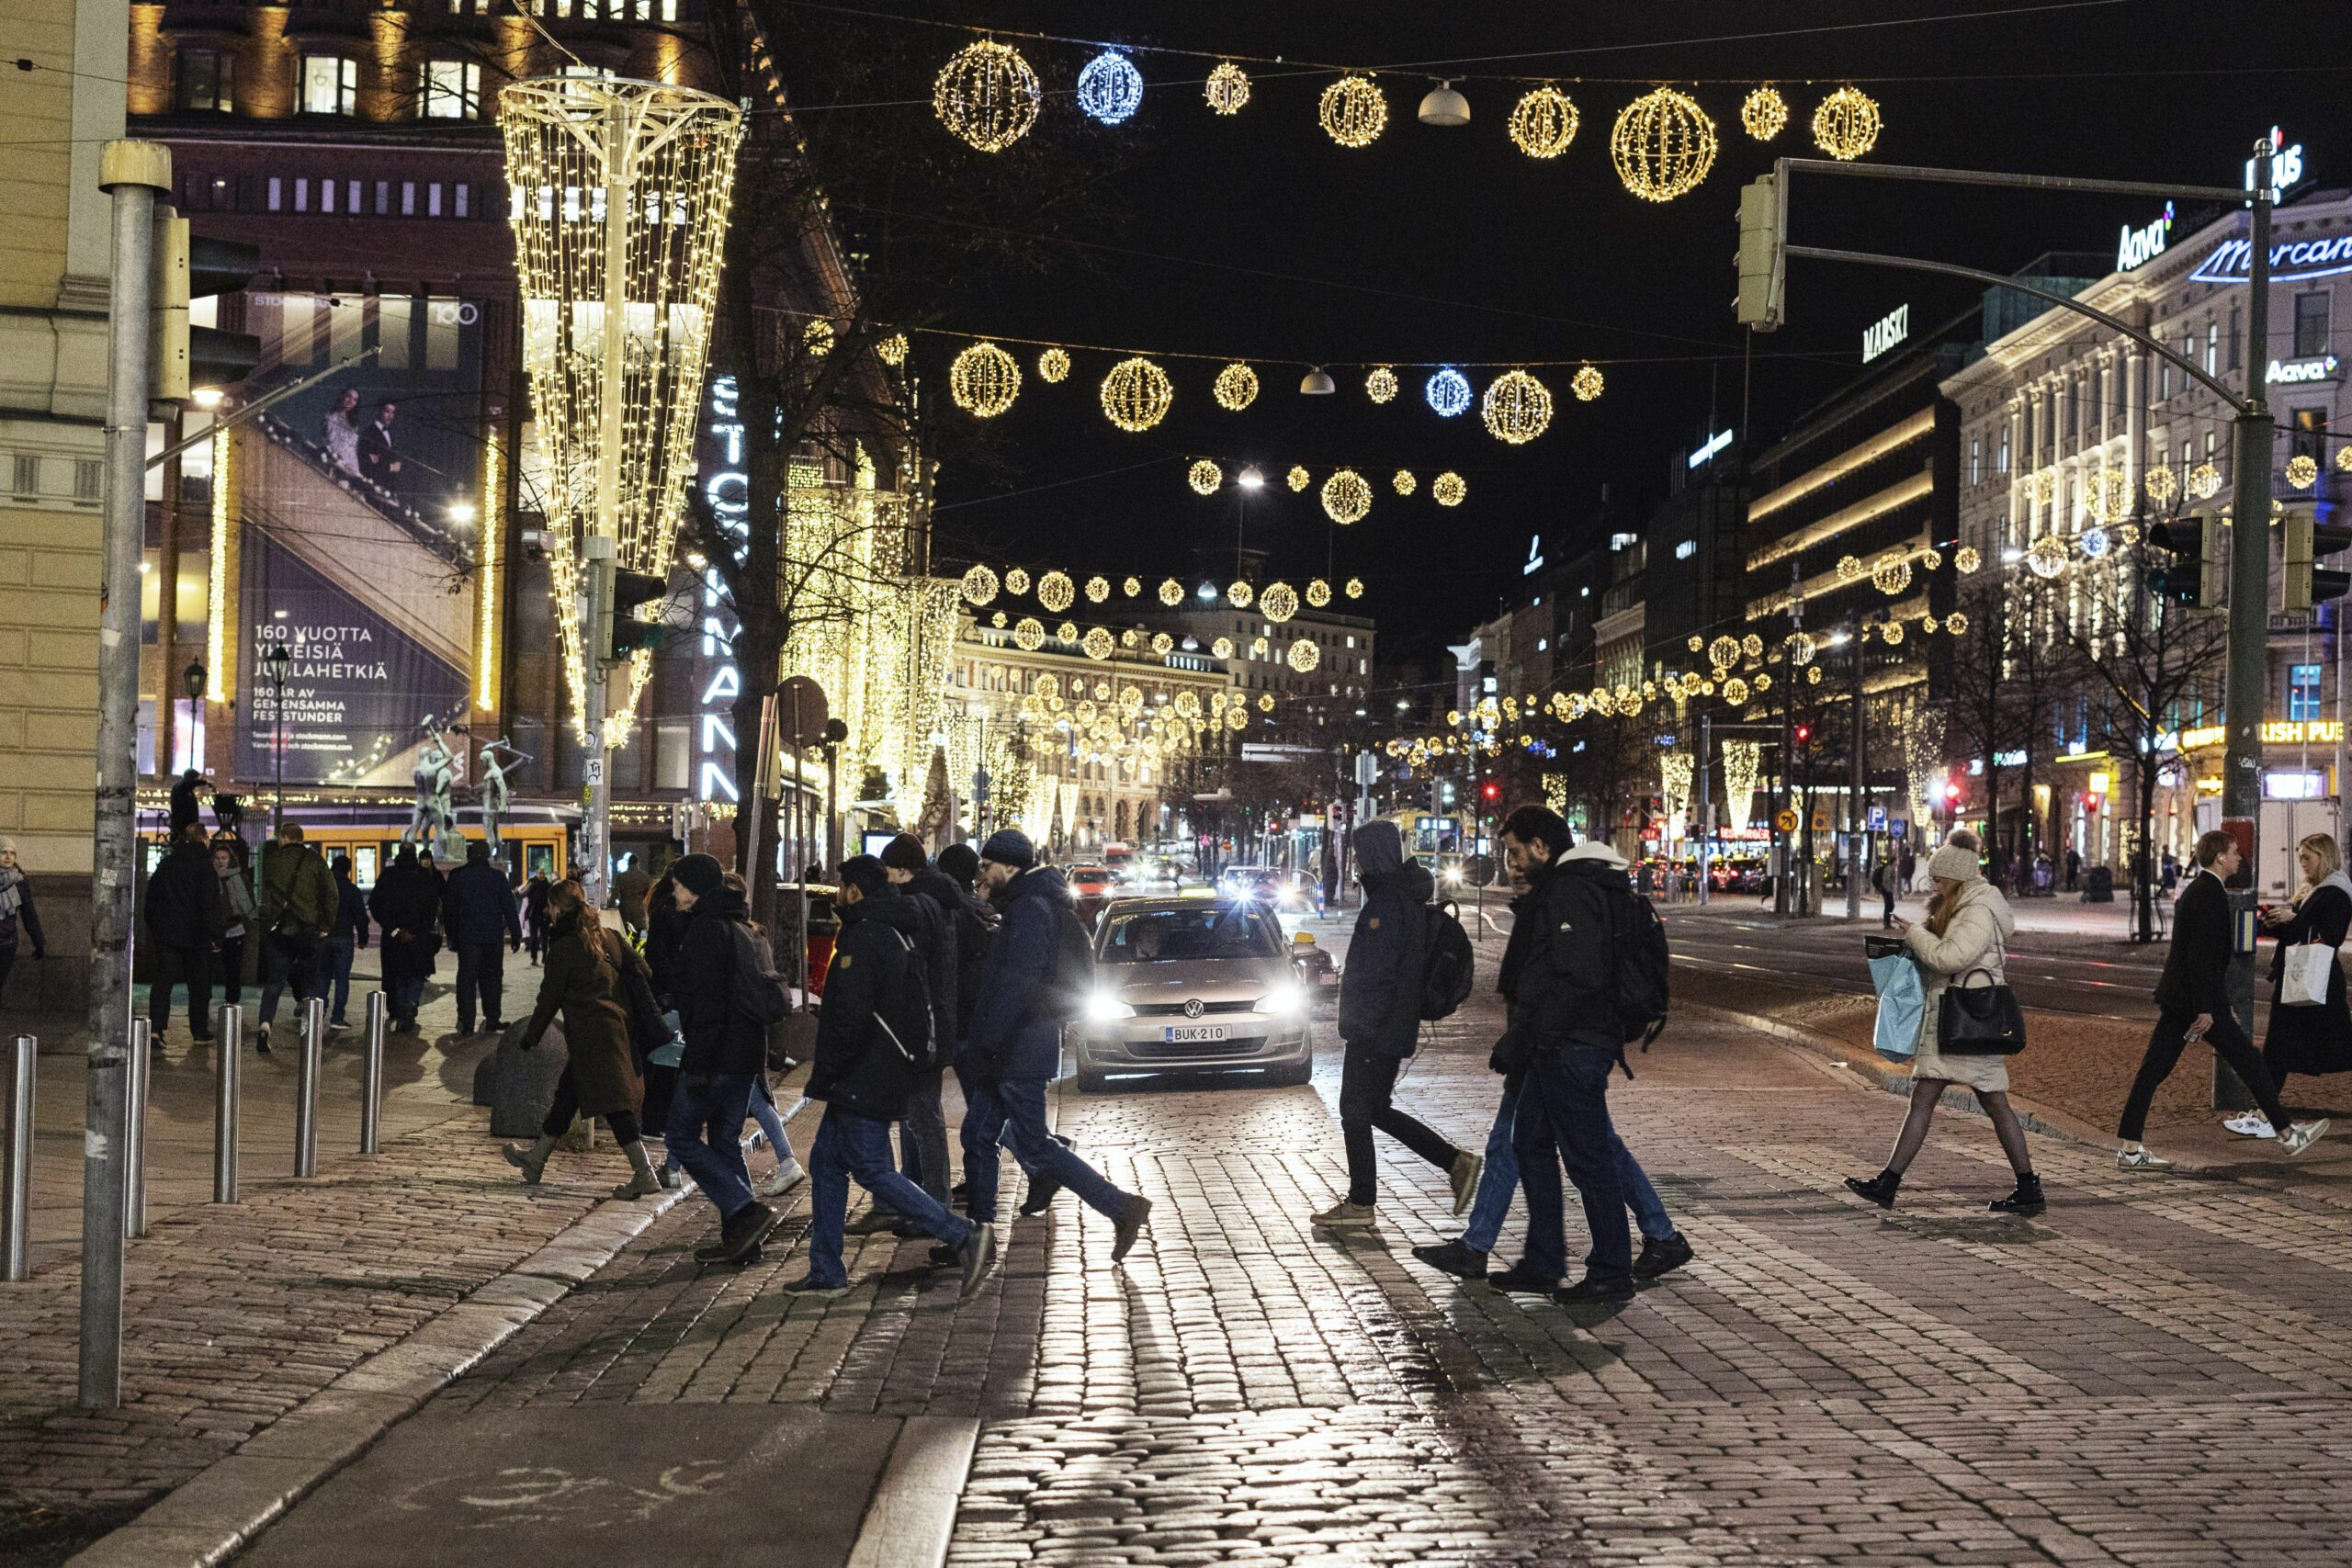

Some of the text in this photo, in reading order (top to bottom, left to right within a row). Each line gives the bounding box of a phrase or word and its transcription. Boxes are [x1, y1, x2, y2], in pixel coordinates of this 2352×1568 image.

[2117, 224, 2165, 272] Aava
[2190, 235, 2352, 281] Mrcan
[1862, 303, 1908, 364] MARSKI
[2265, 360, 2326, 383] Aava
[255, 625, 372, 642] 160 VUOTTA
[254, 661, 388, 679] JULAHETKIÄ
[254, 688, 274, 697] 160
[298, 689, 315, 699] AV
[253, 710, 343, 723] FESSTUNDER
[2261, 722, 2303, 741] RISH
[1174, 1028, 1223, 1040] BUK-210
